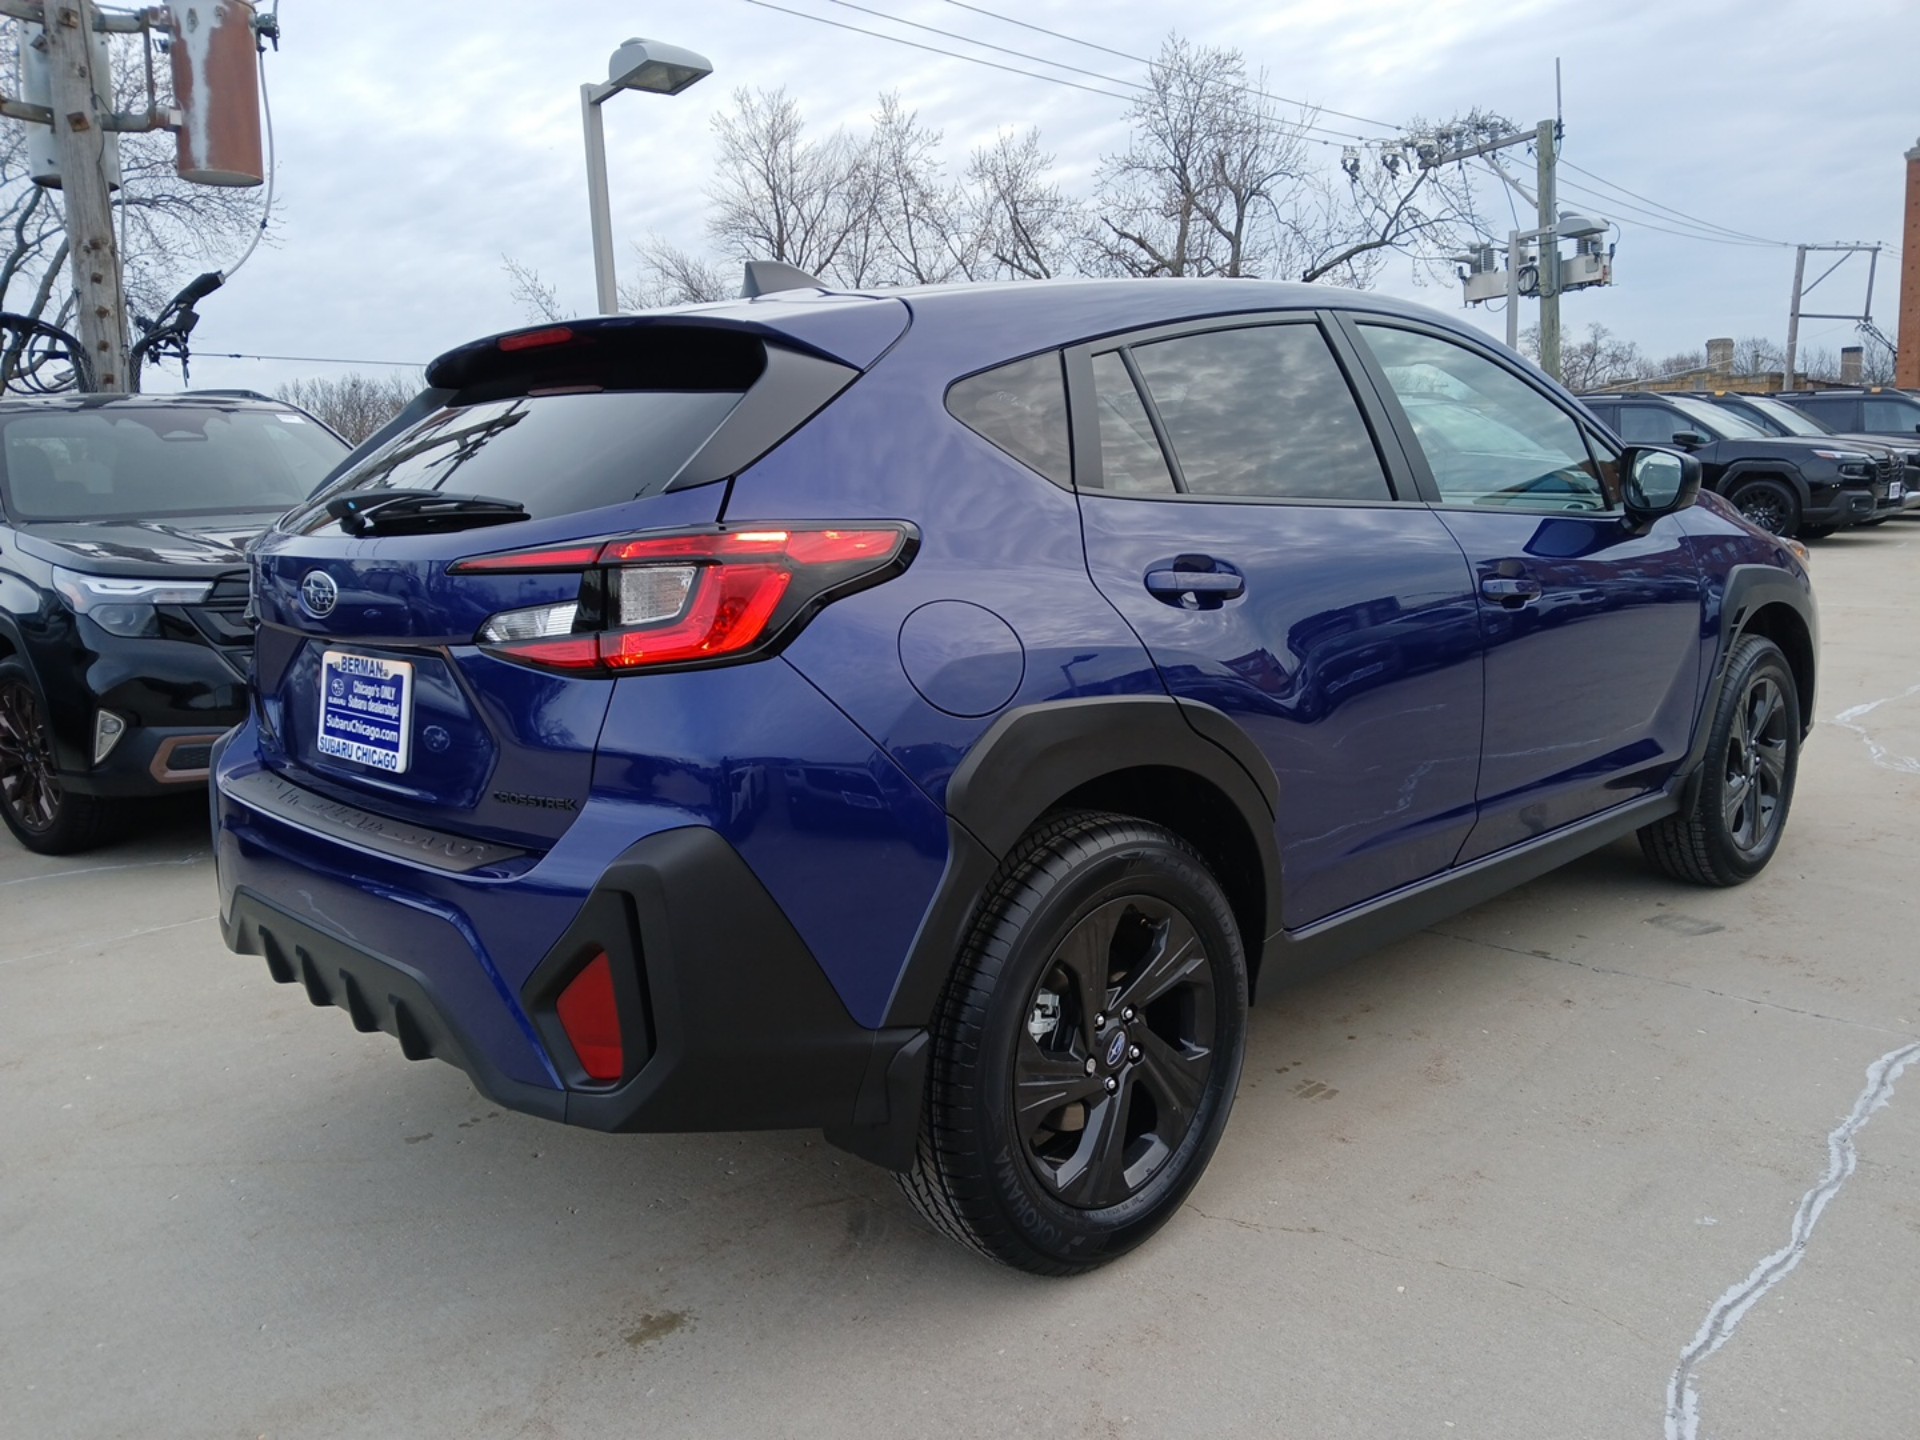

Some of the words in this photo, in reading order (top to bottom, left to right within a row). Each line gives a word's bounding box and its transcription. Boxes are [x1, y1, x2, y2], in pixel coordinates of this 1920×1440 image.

[341, 656, 384, 677] BERMAN
[326, 714, 398, 743] SubaruChicago.com
[320, 736, 353, 758] SUBARU
[355, 746, 397, 770] CHICAGO
